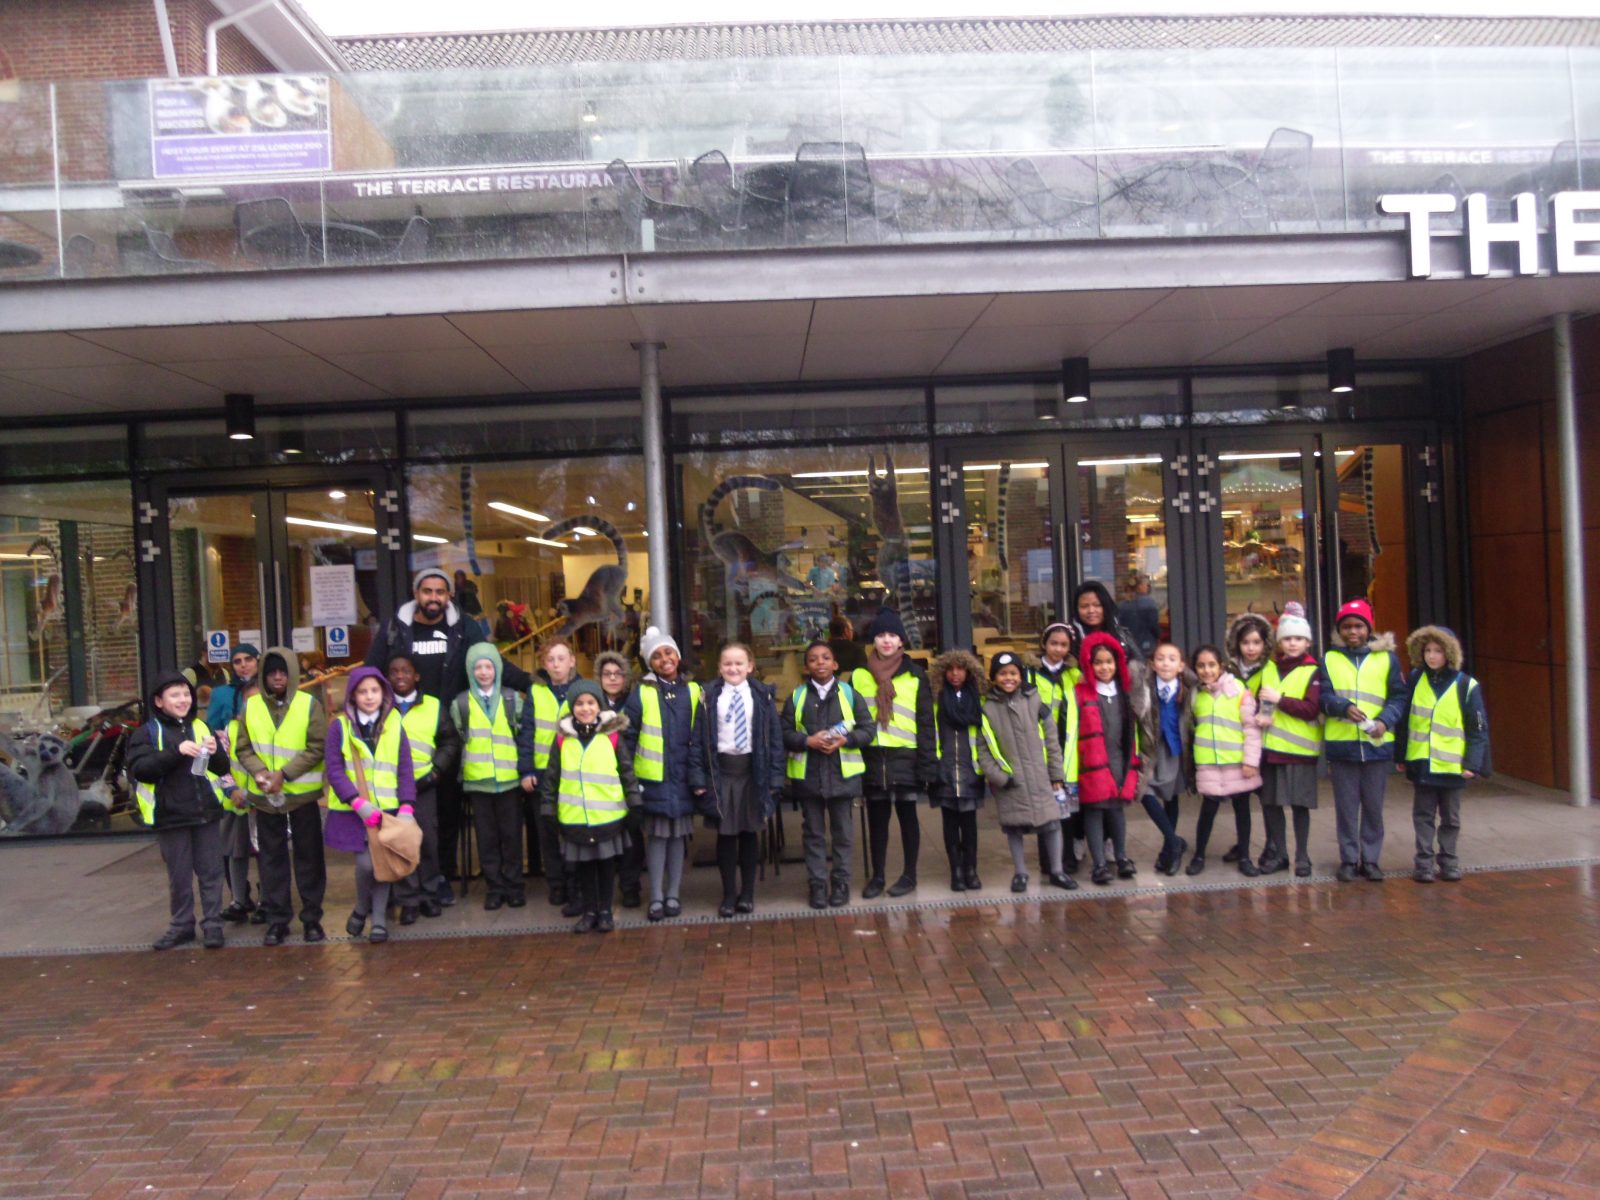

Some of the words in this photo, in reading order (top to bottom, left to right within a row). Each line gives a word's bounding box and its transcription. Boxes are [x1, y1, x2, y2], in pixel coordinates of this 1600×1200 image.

[1369, 150, 1407, 165] THE
[353, 180, 394, 198] THE
[397, 176, 491, 196] TERRACE
[1376, 191, 1600, 278] THE
